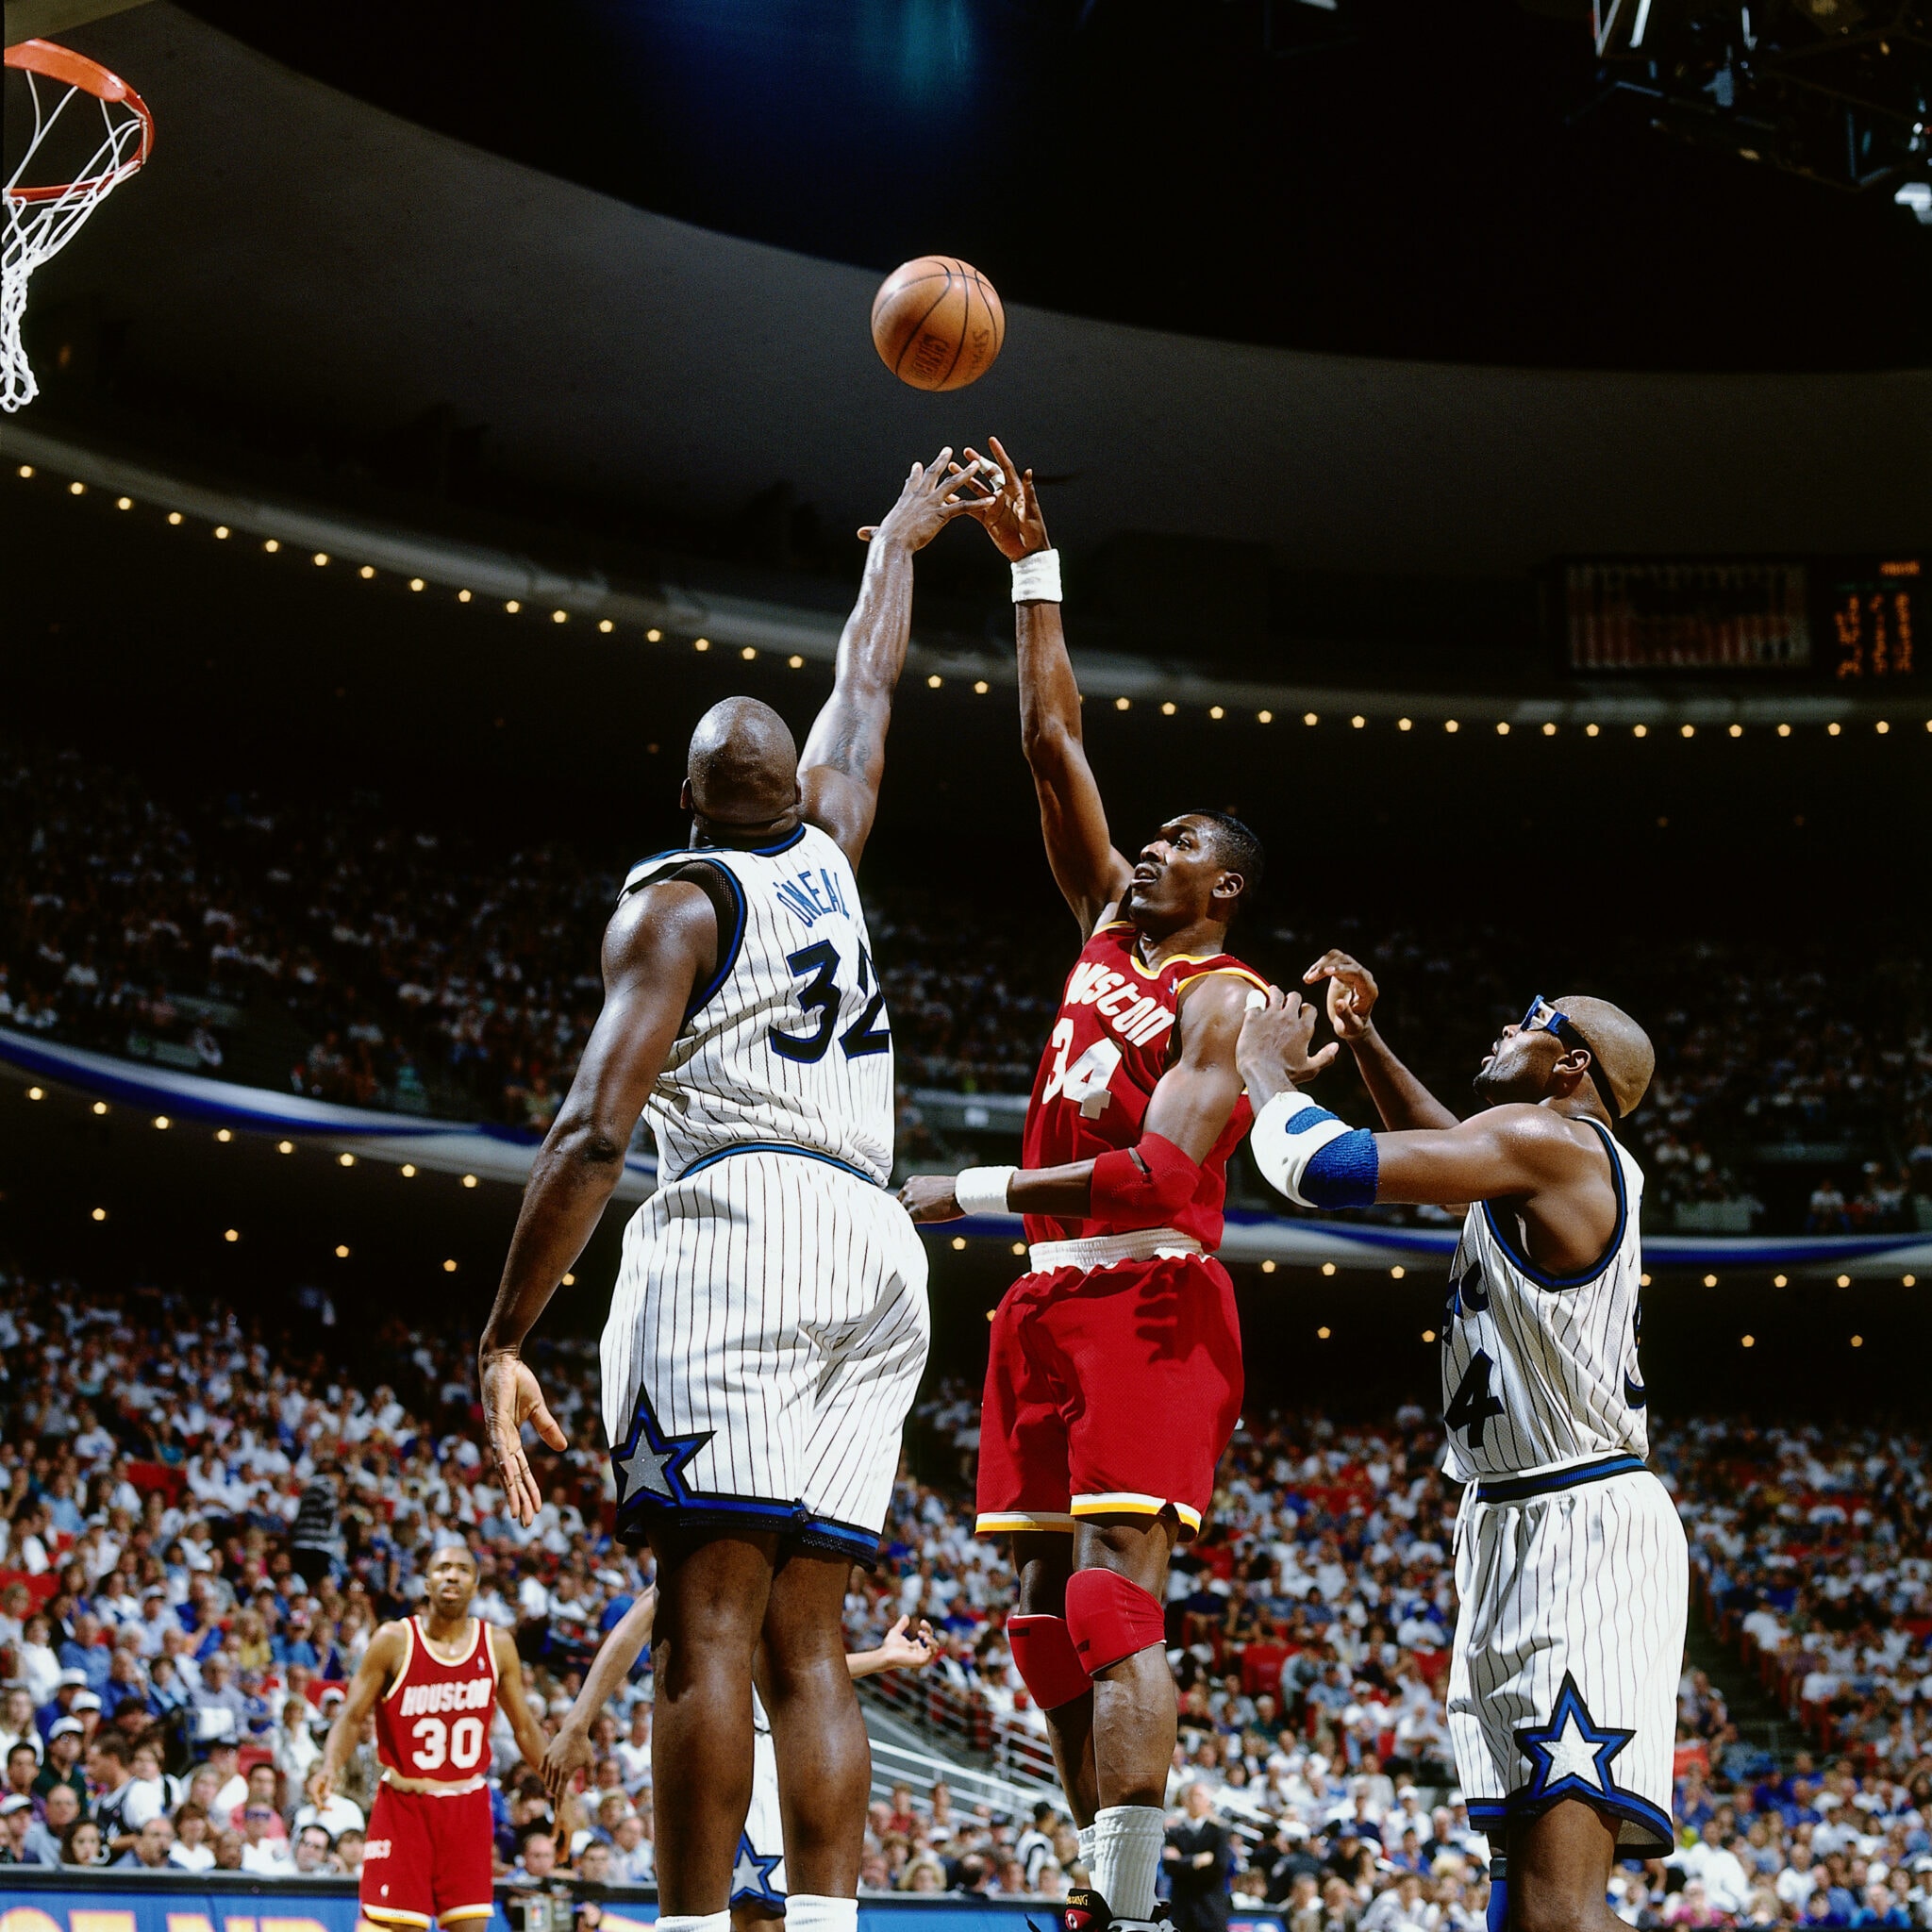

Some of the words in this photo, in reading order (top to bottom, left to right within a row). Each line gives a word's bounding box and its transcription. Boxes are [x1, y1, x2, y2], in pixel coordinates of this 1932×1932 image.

[768, 936, 891, 1064] 32
[1064, 961, 1176, 1048] USTON
[1041, 1017, 1123, 1121] 34
[400, 1677, 492, 1717] HOUSTON
[412, 1717, 484, 1770] 30
